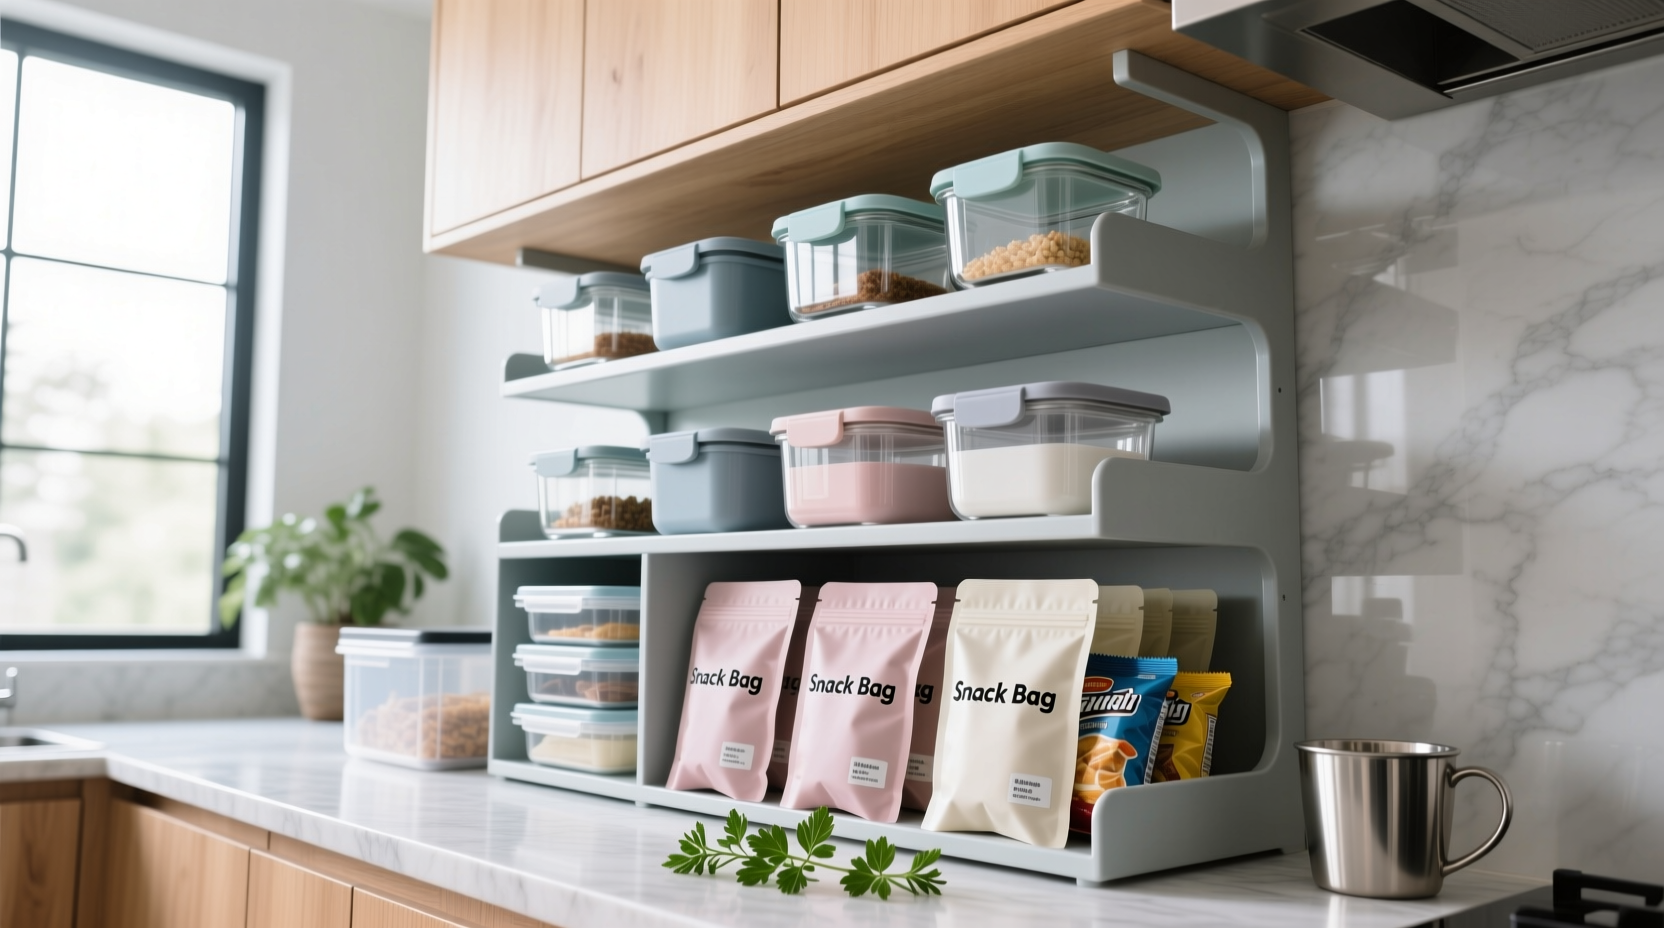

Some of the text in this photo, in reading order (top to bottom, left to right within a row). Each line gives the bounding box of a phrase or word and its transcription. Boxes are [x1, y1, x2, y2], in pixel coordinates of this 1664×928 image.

[690, 667, 763, 695] Snack Bag
[809, 673, 854, 695] Snack
[857, 676, 896, 705] Bag
[953, 680, 1008, 704] Snack
[1011, 684, 1057, 714] Bag
